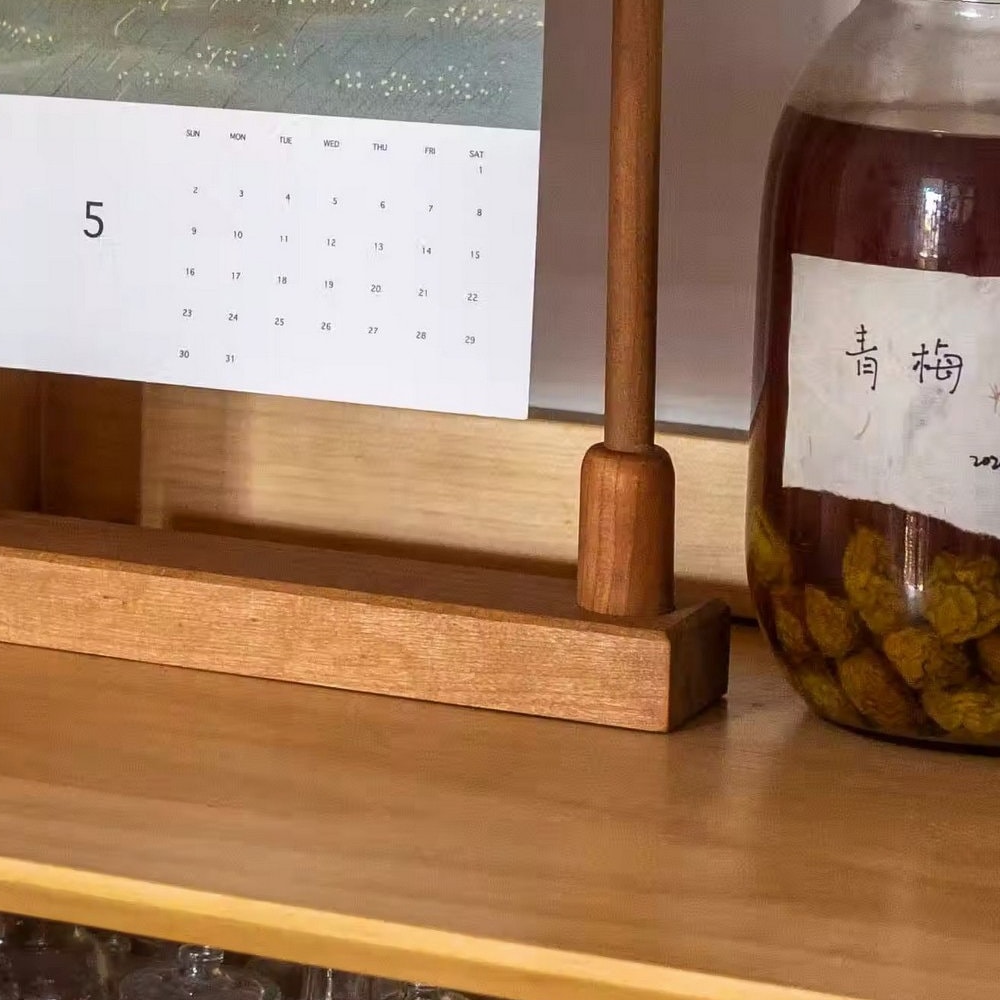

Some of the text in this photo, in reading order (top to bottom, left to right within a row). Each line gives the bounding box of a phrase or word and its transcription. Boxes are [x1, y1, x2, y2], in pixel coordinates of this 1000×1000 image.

[185, 128, 484, 159] SUN MON TUE WED THU FRI SAT
[479, 165, 483, 174] 1
[192, 186, 483, 217] 2 3 4 5 6 7 8
[83, 201, 104, 238] 5
[191, 226, 481, 260] 9 10 11 12 13 14 15
[185, 267, 479, 302] 16 17 18 19 20 21 22
[182, 308, 476, 345] 23 24 25 26 27 28 29
[178, 349, 235, 363] 30 31
